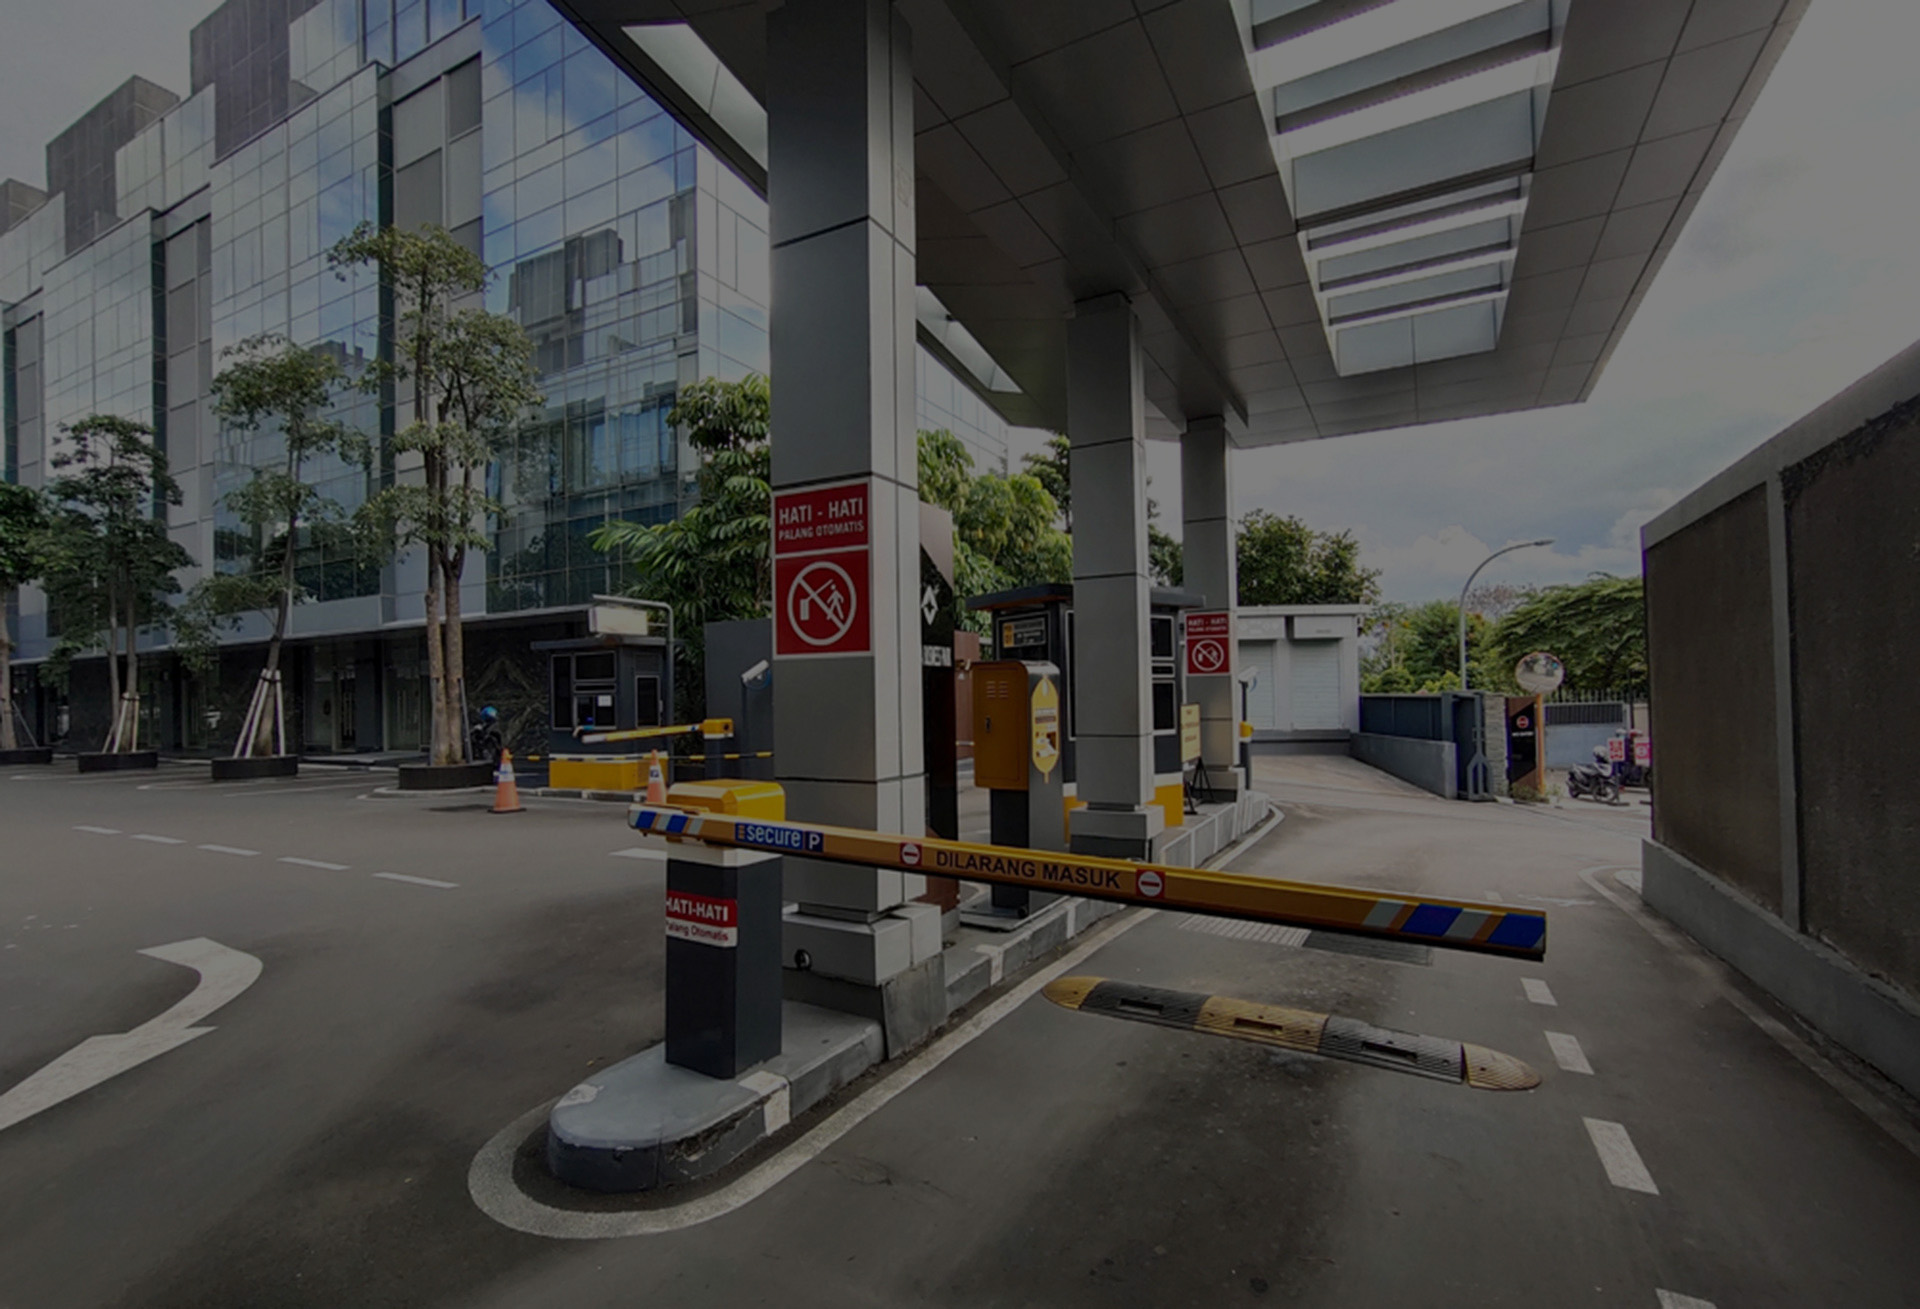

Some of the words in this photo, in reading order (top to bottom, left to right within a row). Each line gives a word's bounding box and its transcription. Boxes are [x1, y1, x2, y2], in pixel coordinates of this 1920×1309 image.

[778, 503, 812, 526] HATI
[828, 497, 864, 519] HATI
[778, 525, 814, 542] PALANG
[815, 519, 865, 537] OTOMATIS
[746, 825, 801, 848] secure
[808, 832, 821, 851] P
[936, 851, 1036, 878] DILARANG
[1042, 863, 1121, 889] MASUK
[666, 896, 729, 922] HATI-HATI
[691, 925, 729, 942] Otomatis
